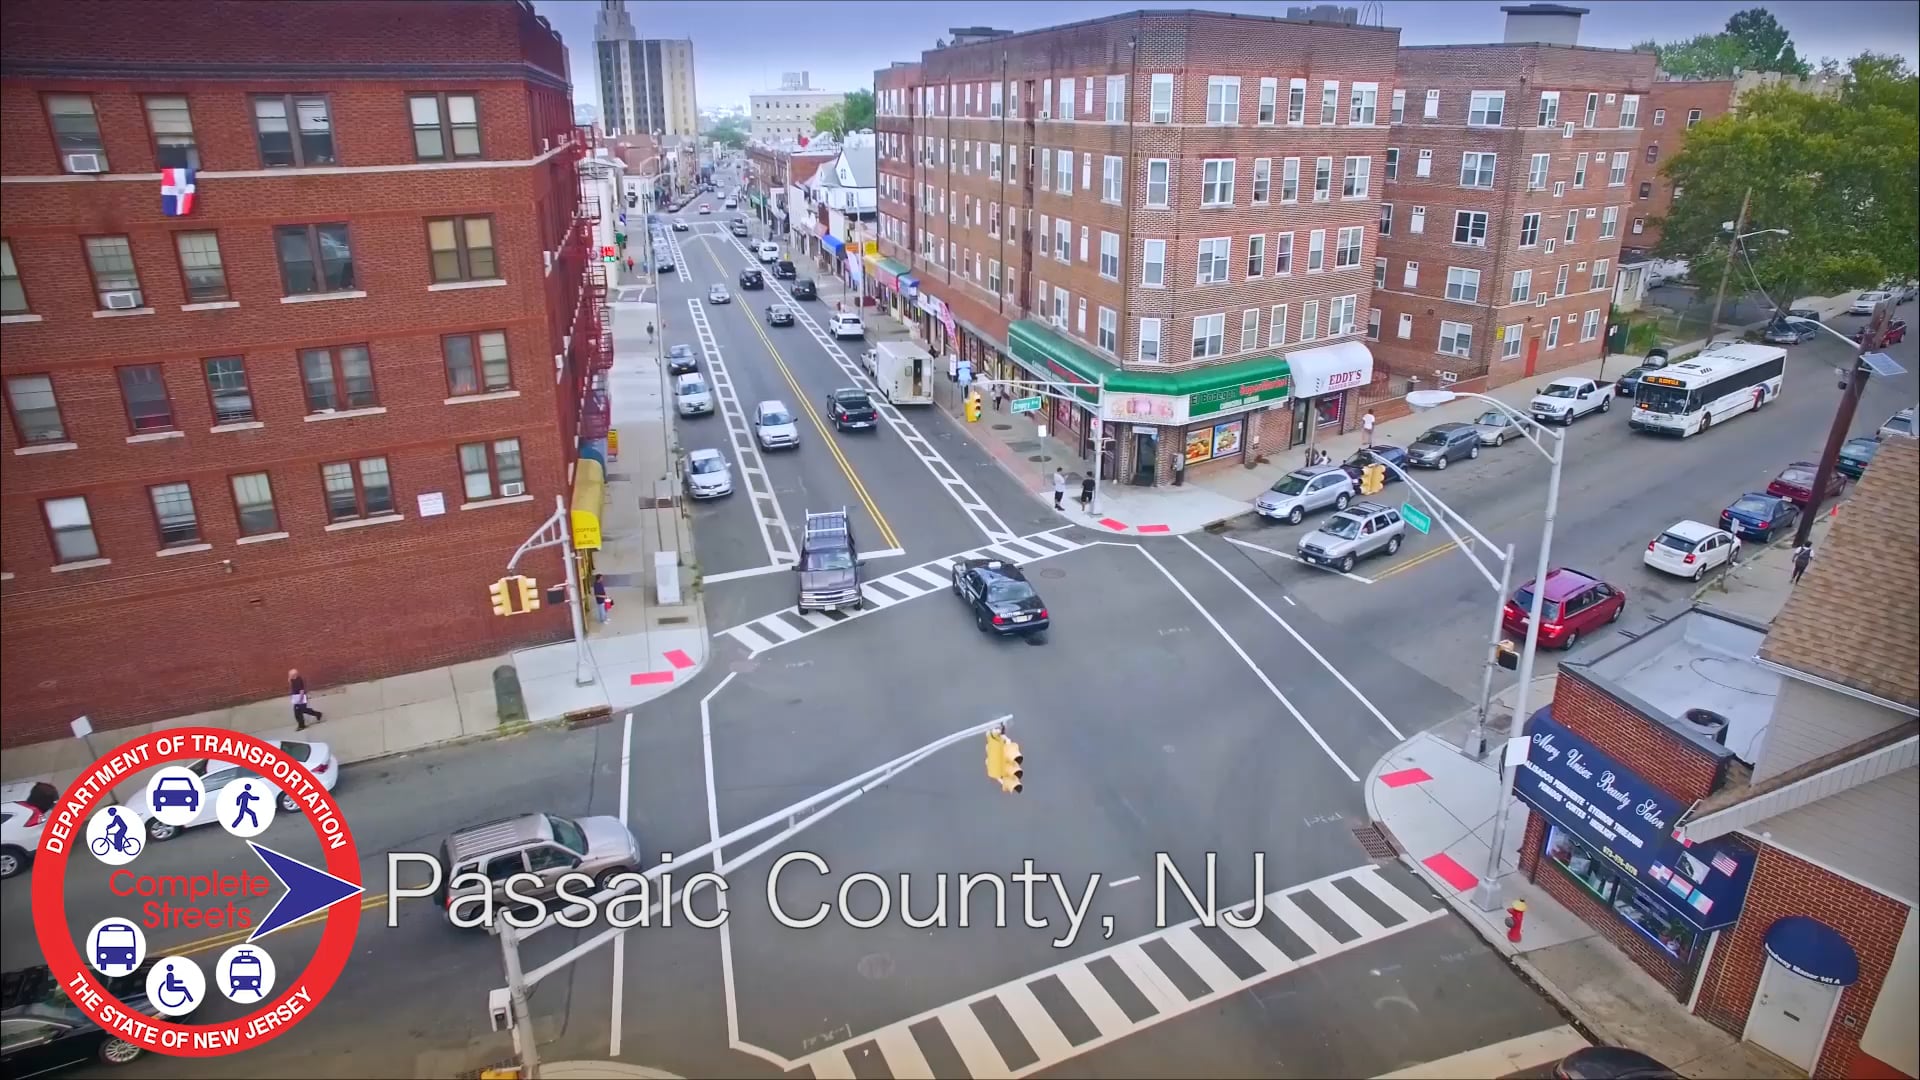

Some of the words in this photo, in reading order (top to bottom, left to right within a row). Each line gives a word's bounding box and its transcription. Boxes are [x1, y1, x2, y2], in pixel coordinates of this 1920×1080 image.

[1329, 369, 1362, 385] EDDY'S
[1533, 733, 1561, 761] Mary
[1566, 748, 1593, 780] Unisex
[1597, 770, 1631, 810] Beauty
[1635, 799, 1665, 829] Salon
[1792, 965, 1819, 980] Manor
